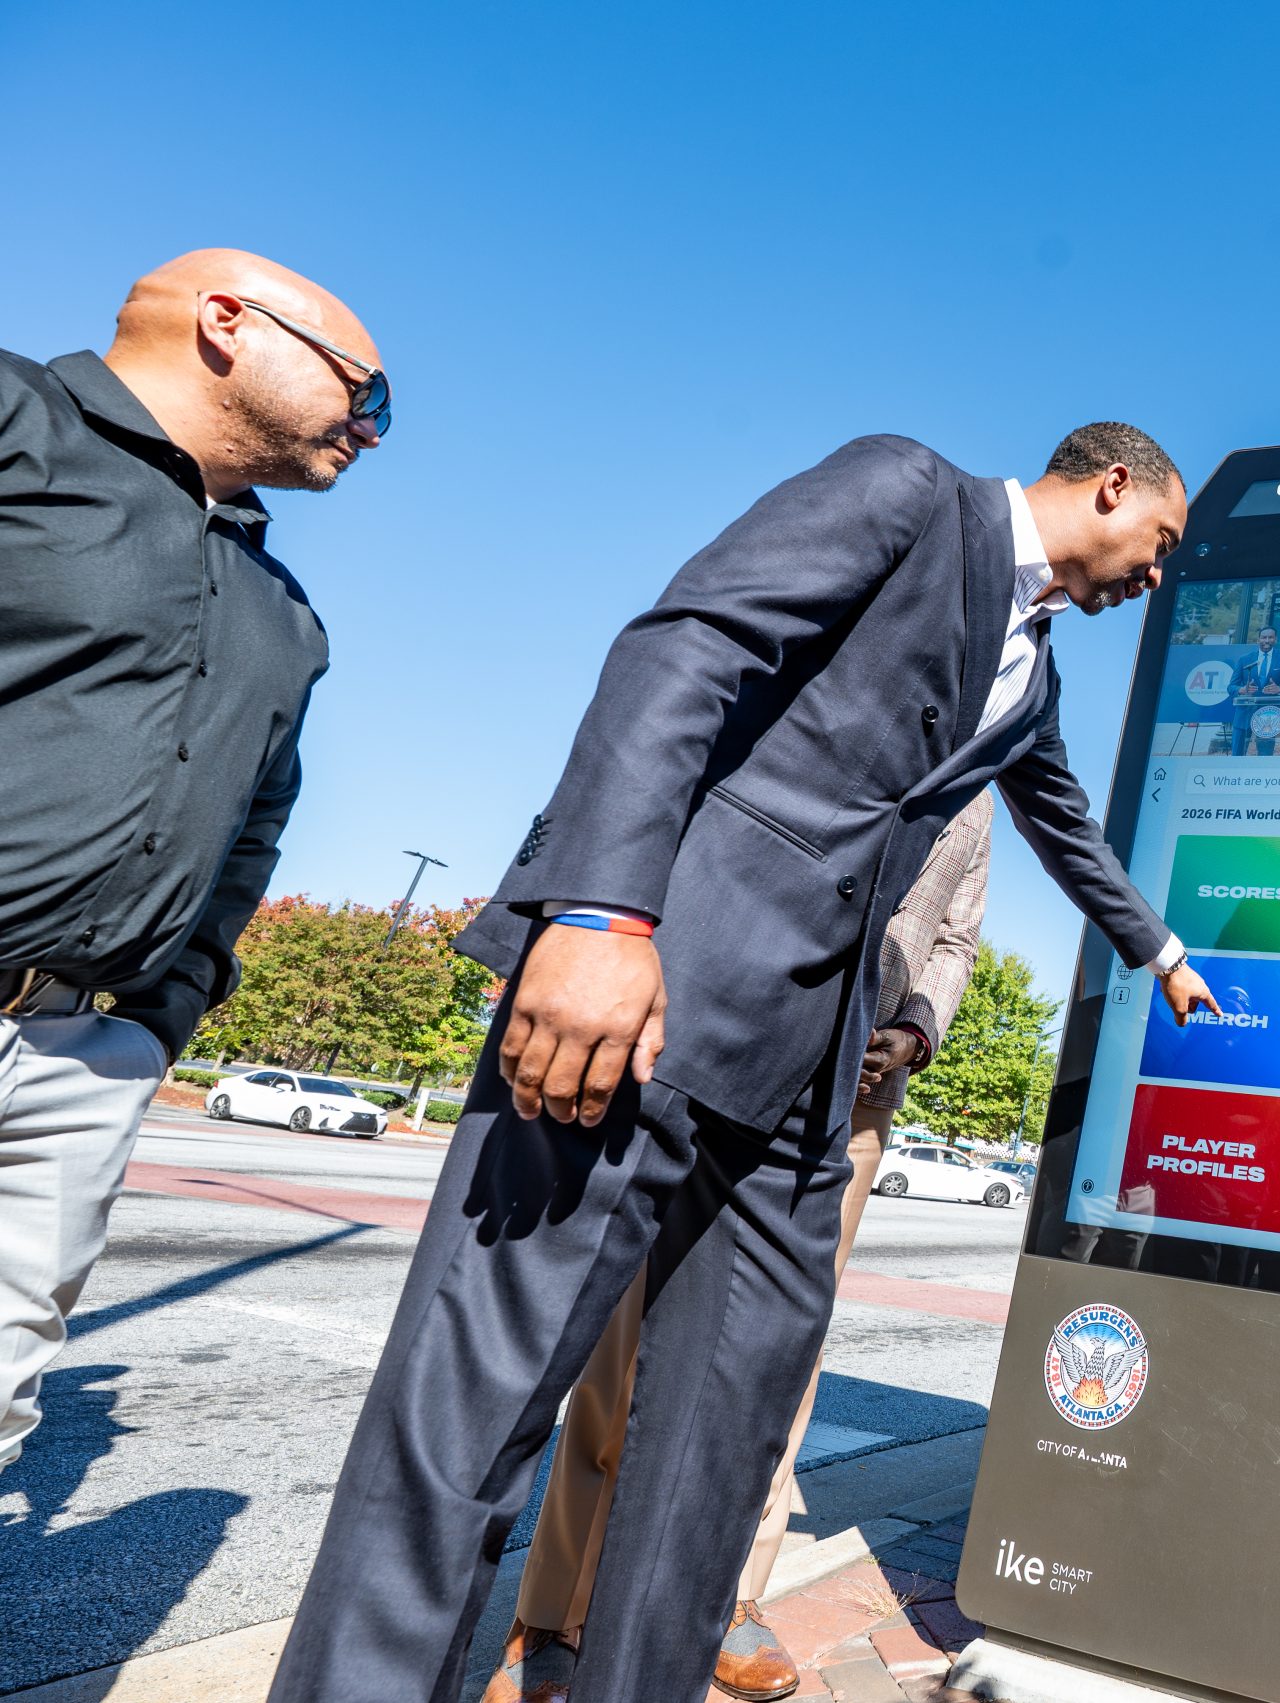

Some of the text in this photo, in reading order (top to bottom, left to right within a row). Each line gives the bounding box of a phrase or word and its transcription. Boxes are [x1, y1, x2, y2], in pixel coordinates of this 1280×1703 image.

[1213, 776, 1241, 786] What
[1244, 778, 1262, 786] are
[1181, 808, 1213, 819] 2026
[1215, 809, 1242, 820] FIFA
[1186, 1010, 1268, 1029] MERCH
[1162, 1134, 1256, 1159] PLAYER
[1146, 1154, 1266, 1183] PROFILES
[1063, 1311, 1139, 1348] RESURGENS
[1051, 1356, 1061, 1387] 1847
[1124, 1367, 1141, 1400] 1865
[1037, 1439, 1063, 1456] CITY
[1062, 1444, 1078, 1458] OF
[995, 1538, 1045, 1585] ike
[1051, 1562, 1094, 1583] SMART
[1049, 1578, 1077, 1595] CITY
